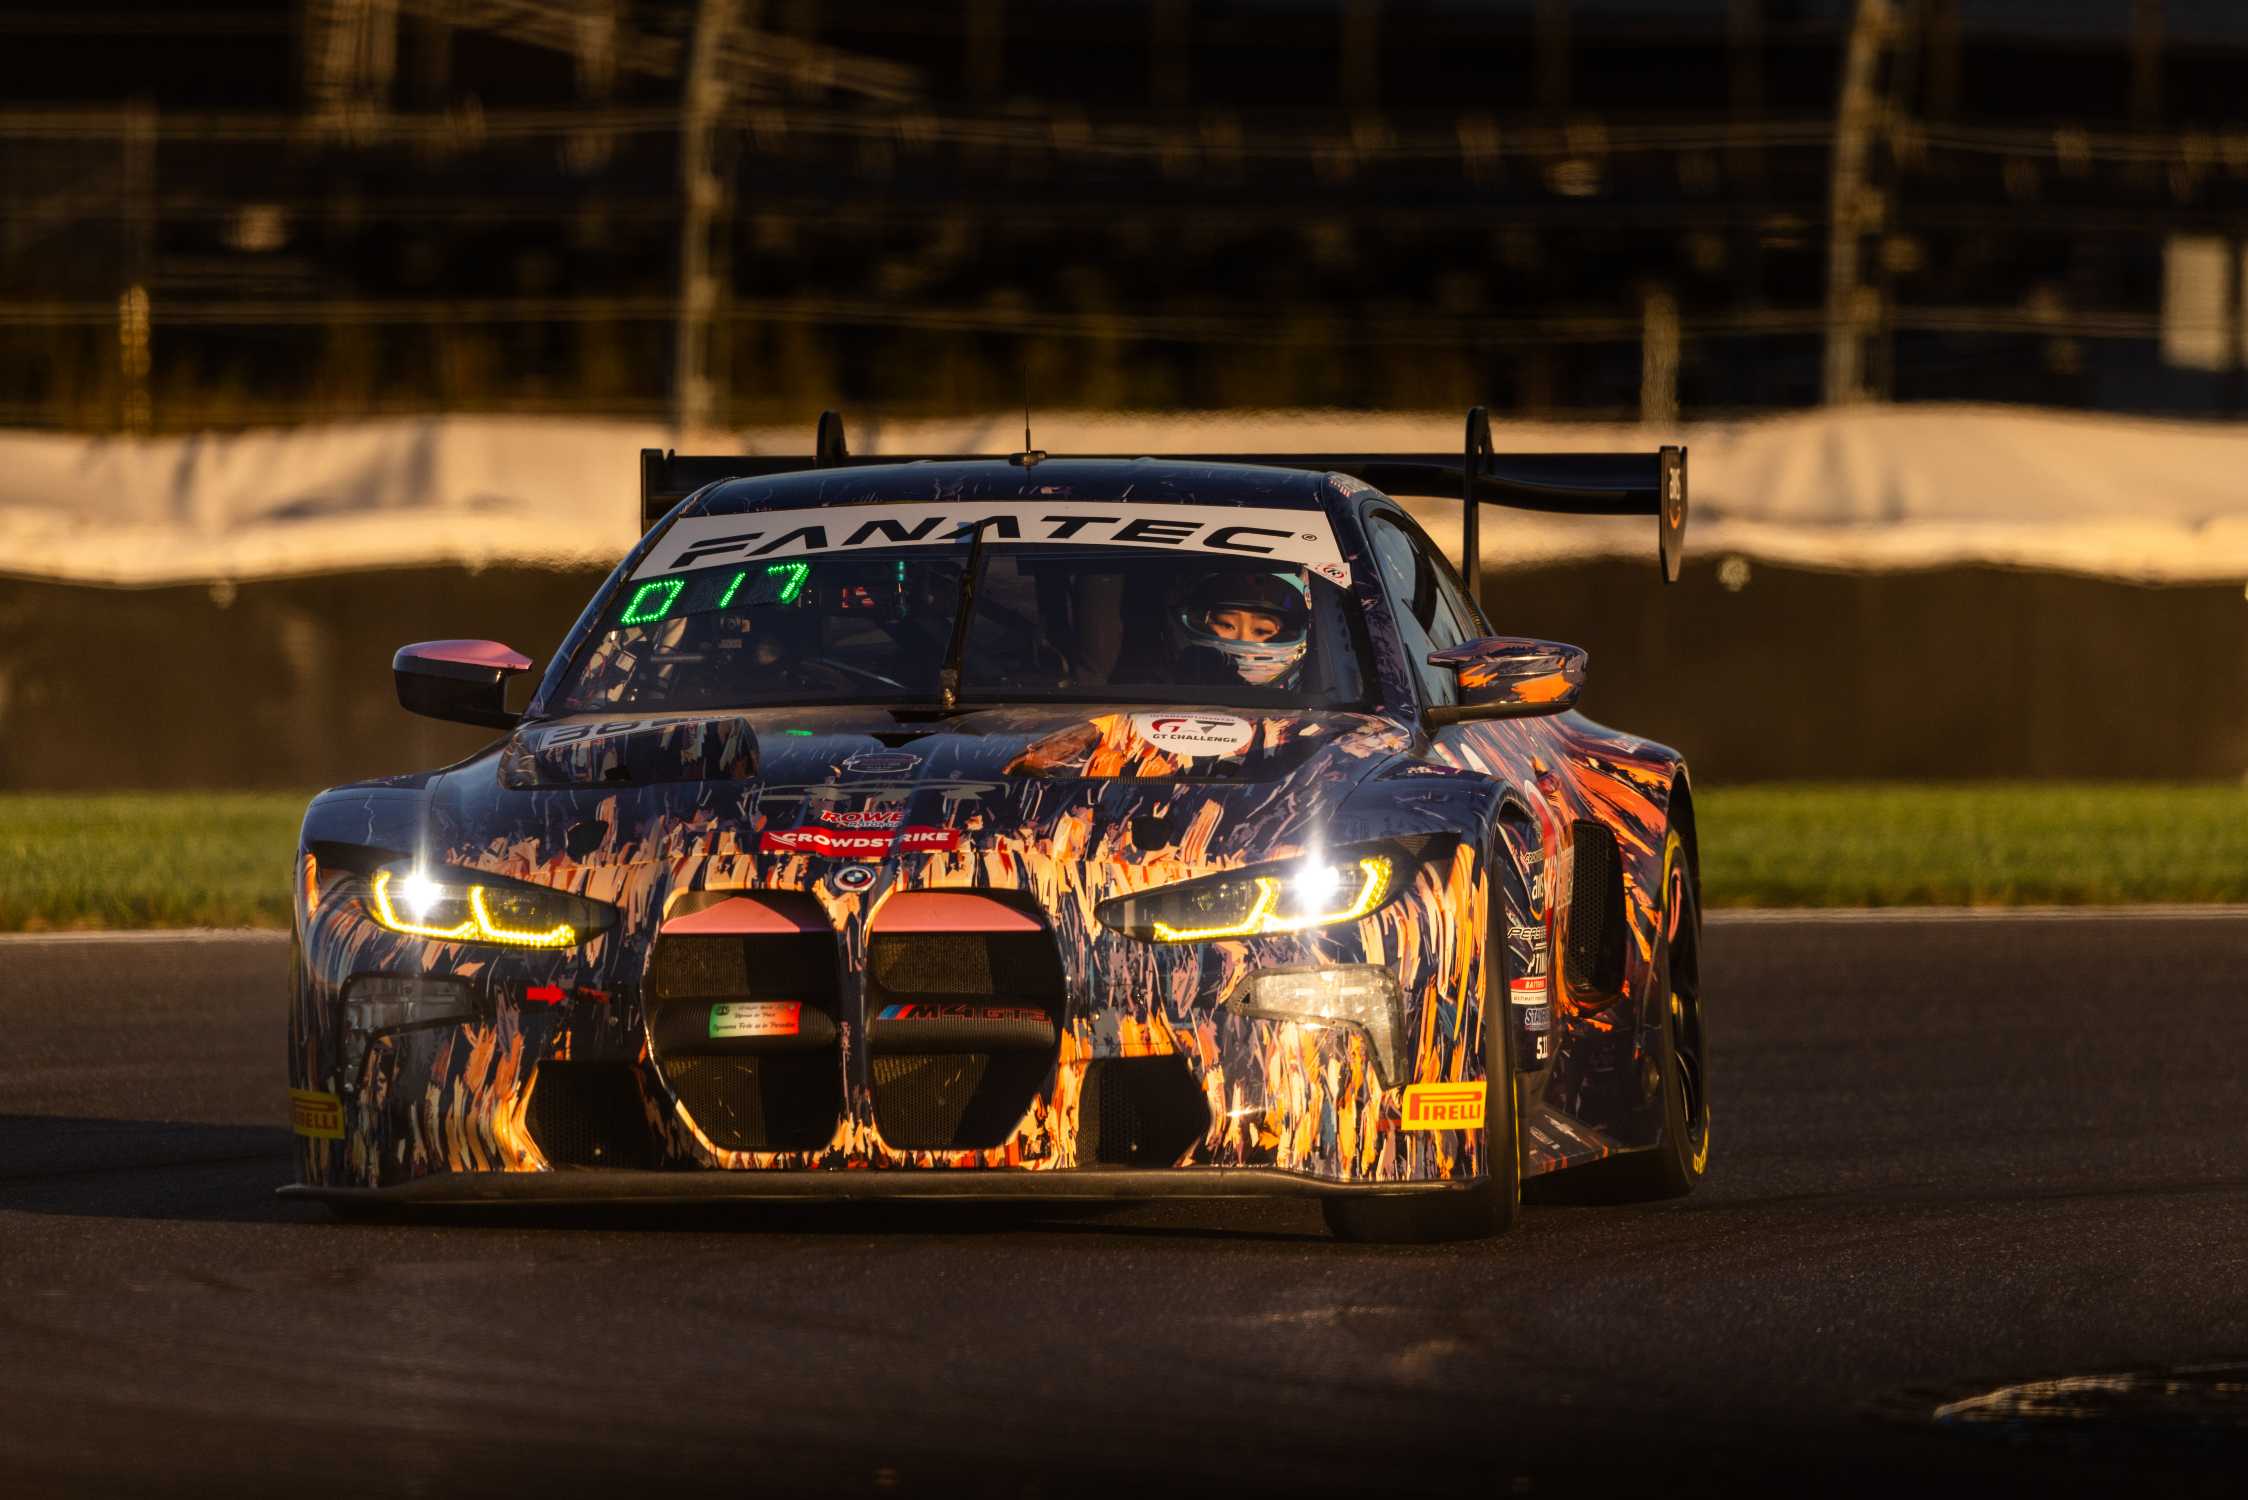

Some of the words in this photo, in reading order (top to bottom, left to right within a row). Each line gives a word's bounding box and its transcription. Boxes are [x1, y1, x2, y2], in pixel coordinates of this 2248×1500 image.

[669, 515, 1297, 569] FANATEC
[1170, 734, 1238, 744] CHALLENGE
[821, 809, 904, 823] ROWE
[781, 831, 950, 849] CROWDSTRIKE
[1409, 1093, 1482, 1121] PIRELLI
